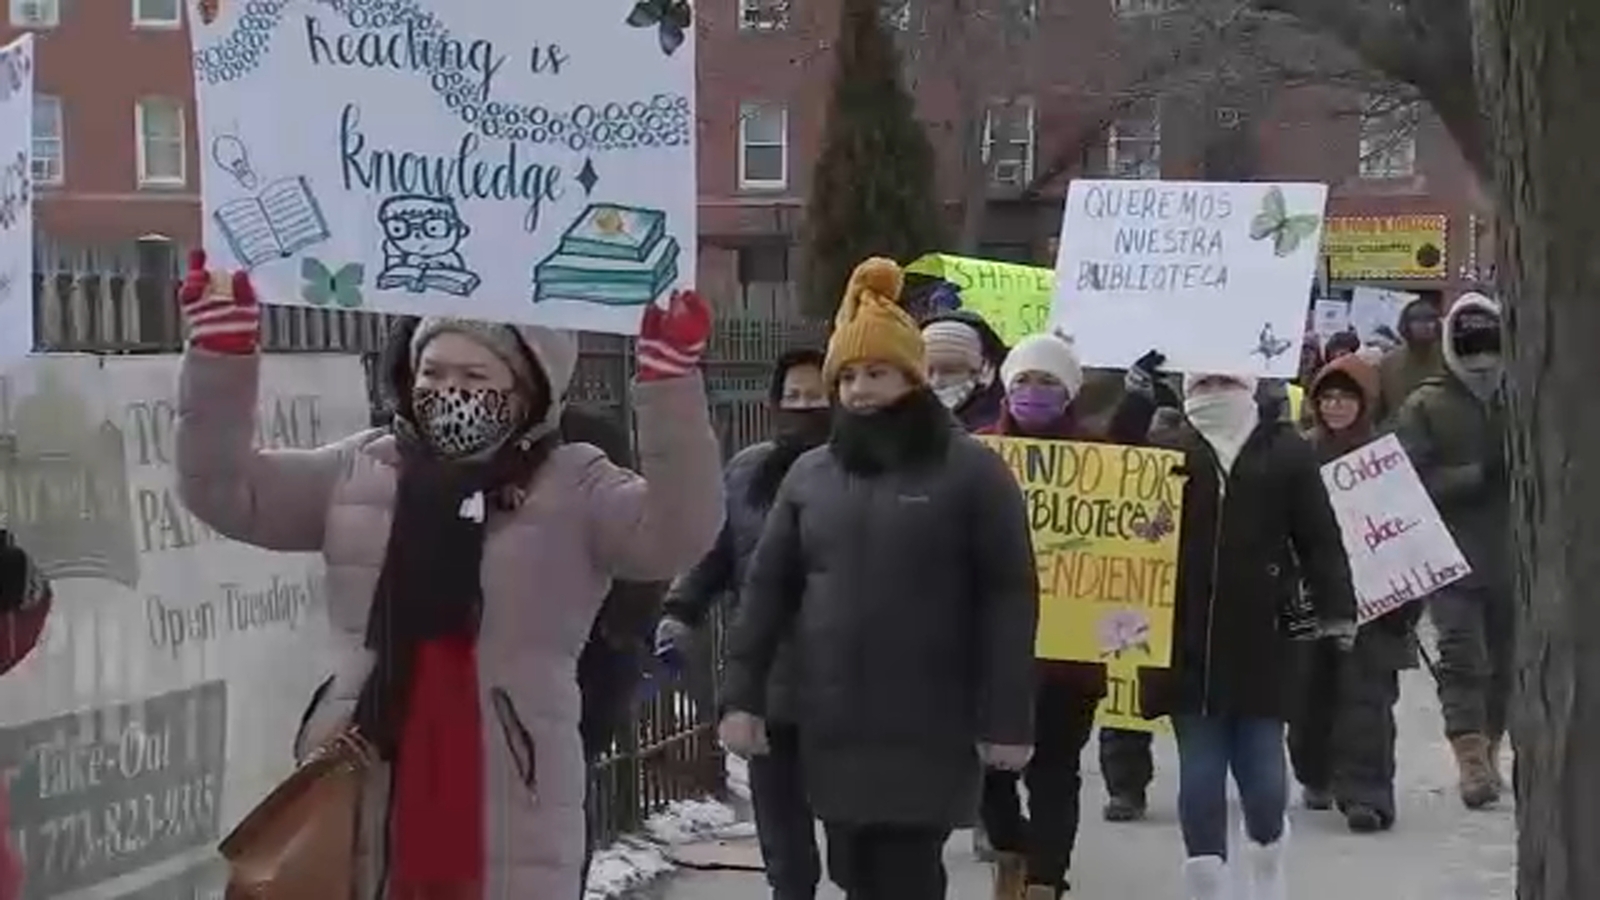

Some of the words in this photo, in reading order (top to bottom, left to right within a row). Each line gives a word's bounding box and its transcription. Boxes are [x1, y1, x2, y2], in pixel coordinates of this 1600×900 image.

[530, 42, 569, 75] is
[1084, 185, 1233, 220] QUEREMOS
[1114, 228, 1223, 254] NUESTRA
[1119, 446, 1180, 511] POR
[1025, 489, 1150, 542] BLIOTECA
[1036, 549, 1174, 608] ENDIENTE
[147, 594, 216, 661] Open
